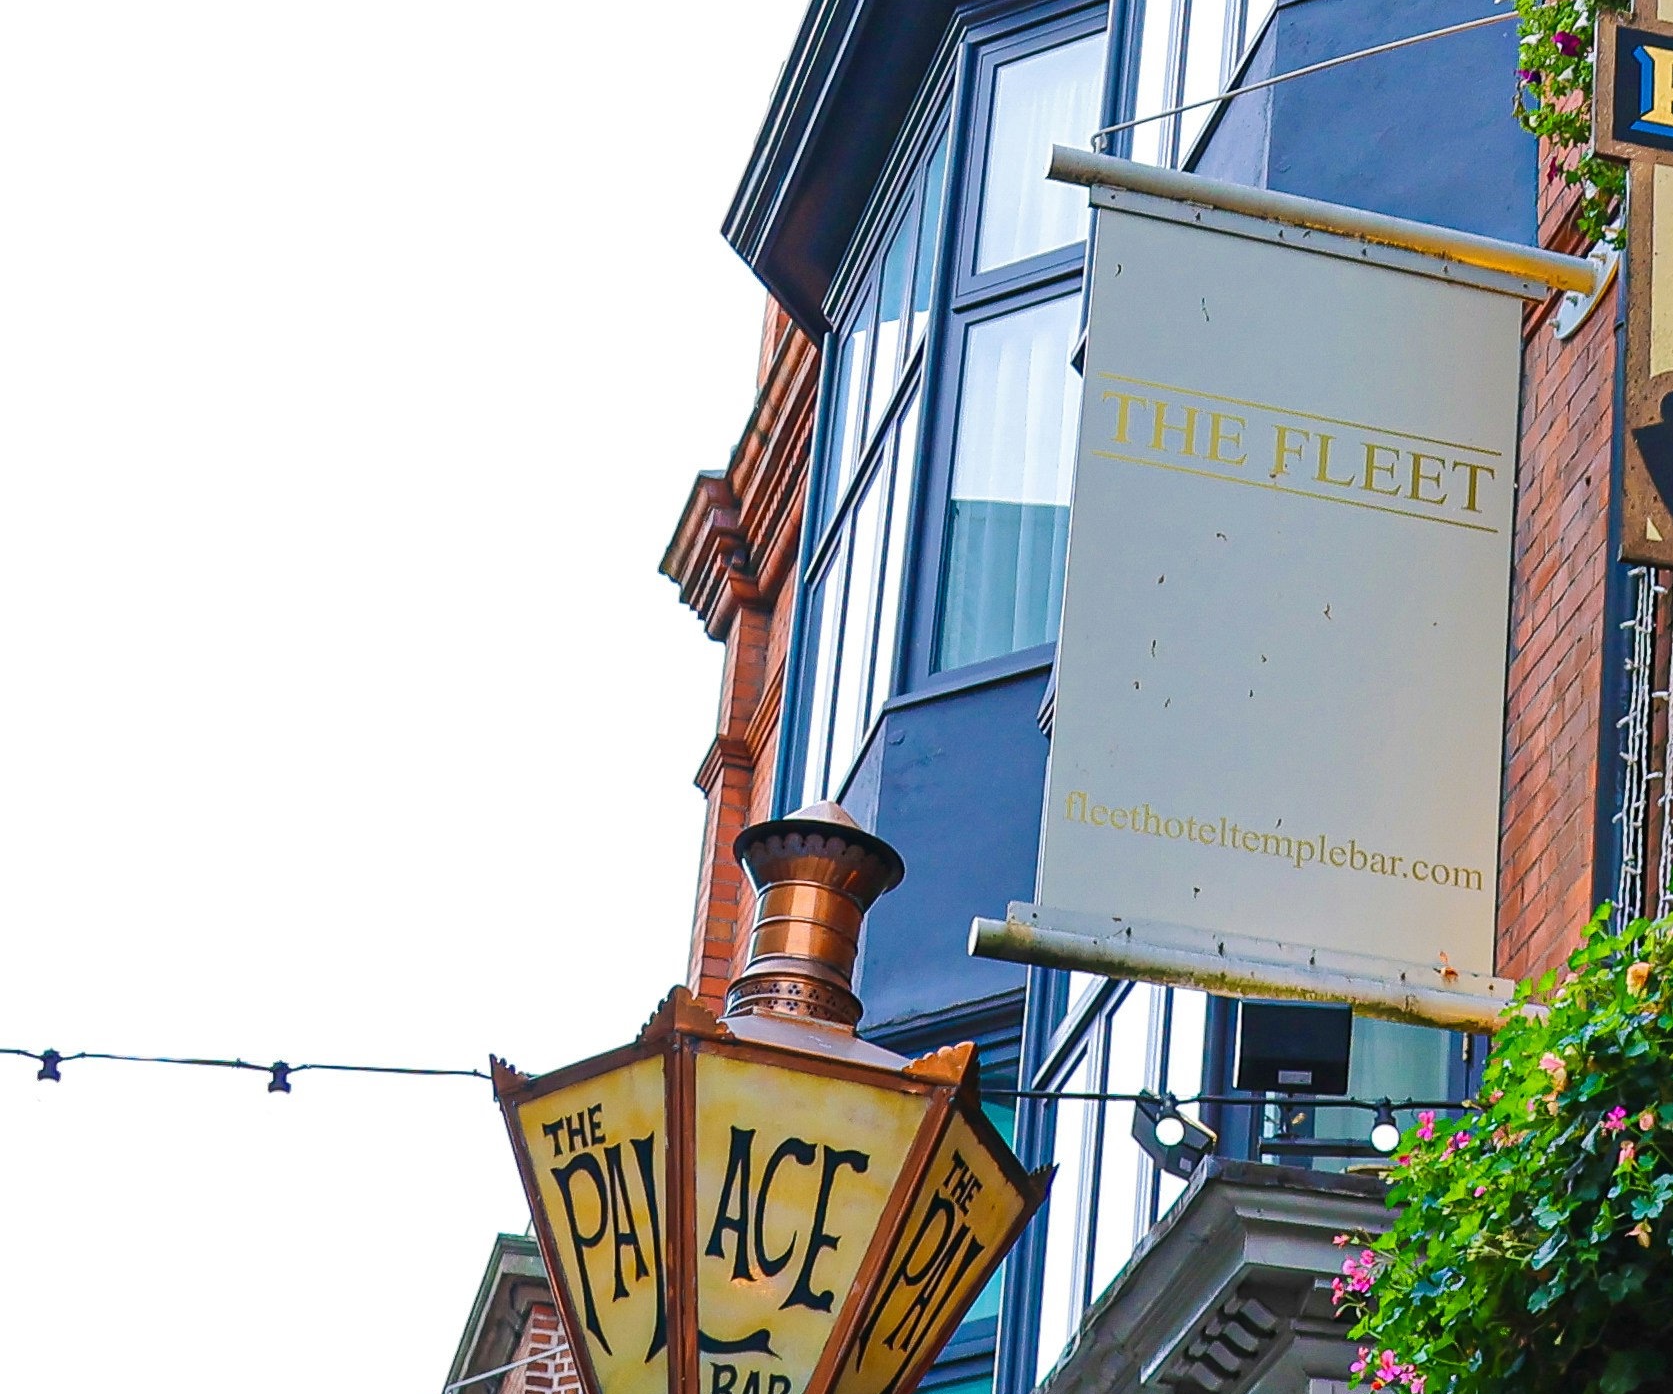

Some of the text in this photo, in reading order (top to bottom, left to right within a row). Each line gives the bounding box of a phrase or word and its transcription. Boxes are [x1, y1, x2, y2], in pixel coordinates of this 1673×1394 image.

[1102, 390, 1497, 516] THE FLEET
[1063, 788, 1486, 893] fleethoteltemplebar.com
[541, 1101, 607, 1159] THE
[941, 1149, 984, 1217] THE
